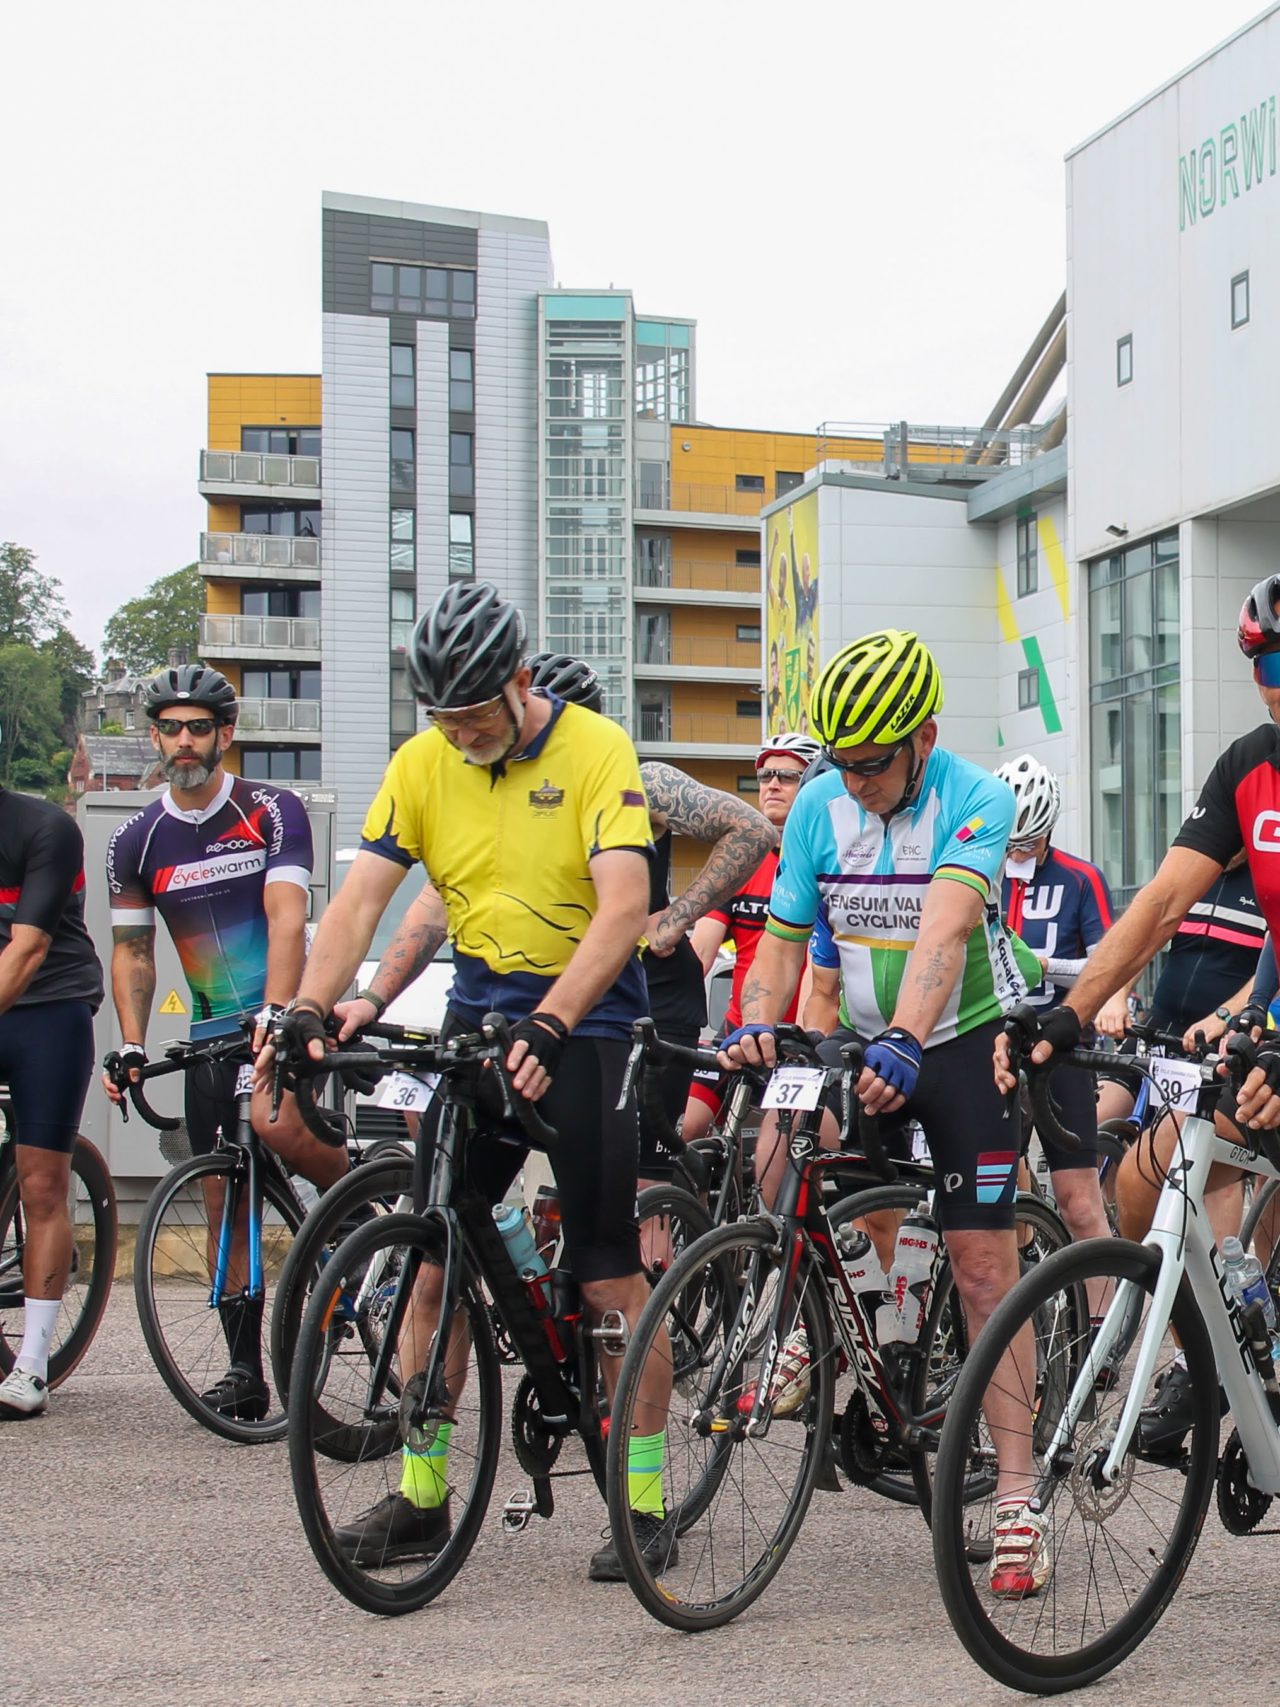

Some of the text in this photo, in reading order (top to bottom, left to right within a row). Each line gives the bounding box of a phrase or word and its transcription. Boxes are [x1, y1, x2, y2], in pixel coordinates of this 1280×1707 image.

[890, 693, 916, 729] LAZER
[251, 788, 284, 857] cycleswarm
[173, 856, 261, 885] cycleswarm
[846, 913, 921, 930] CYCLING
[393, 1087, 418, 1107] 36
[775, 1083, 804, 1105] 37
[1160, 1078, 1182, 1105] 39
[828, 1276, 882, 1391] RIDLEY
